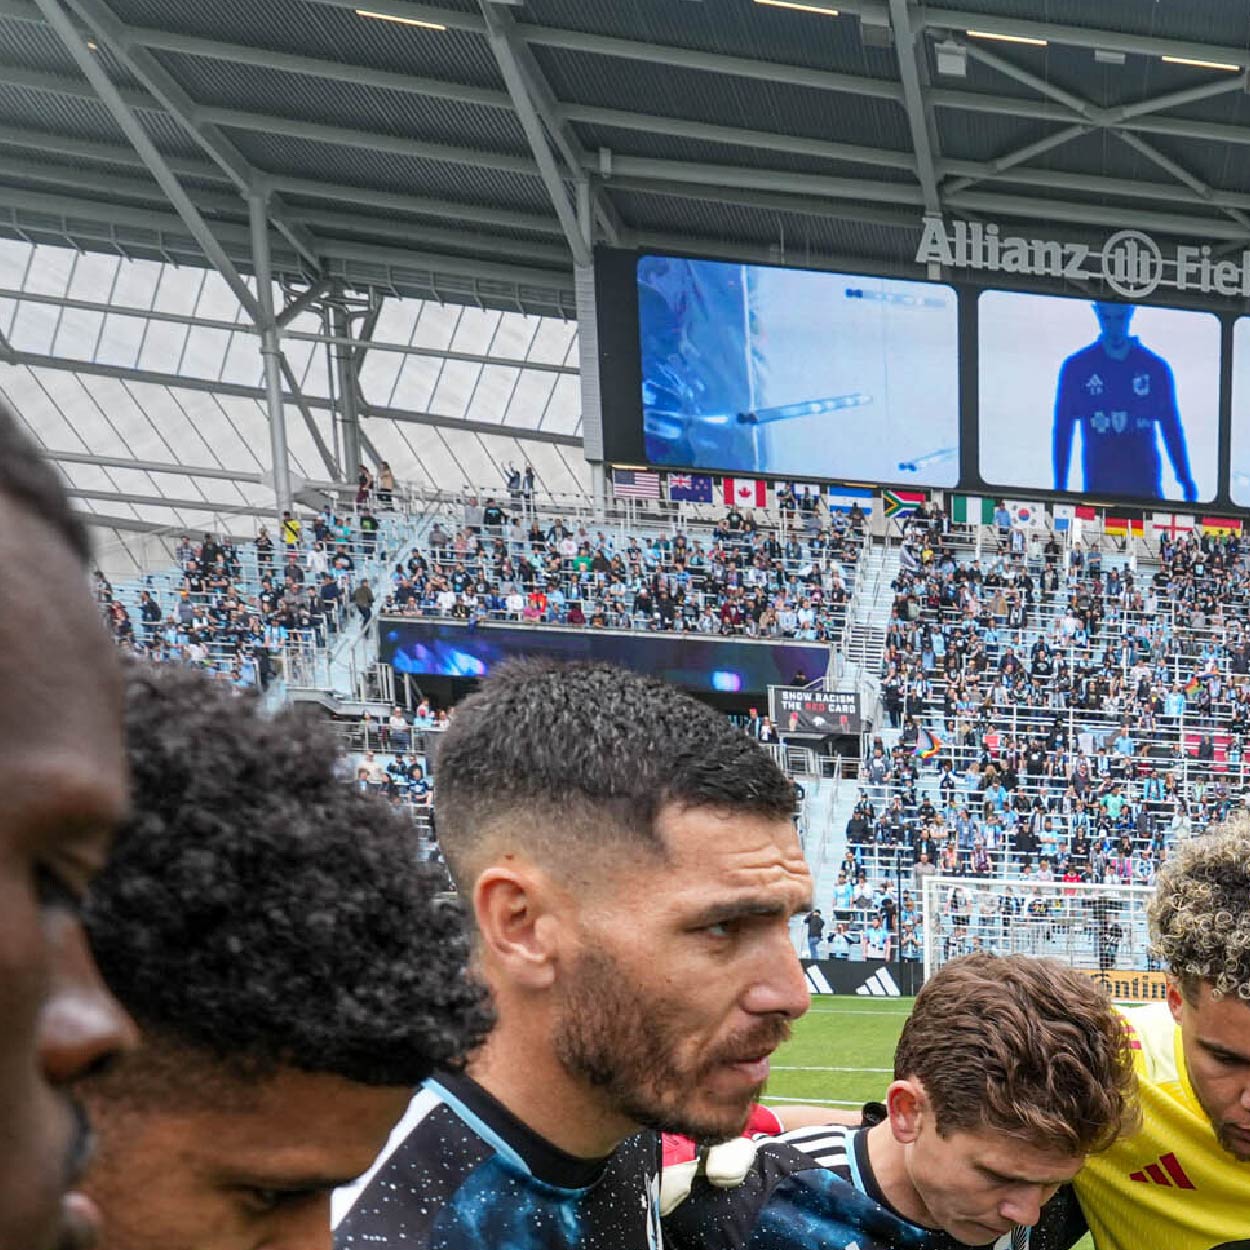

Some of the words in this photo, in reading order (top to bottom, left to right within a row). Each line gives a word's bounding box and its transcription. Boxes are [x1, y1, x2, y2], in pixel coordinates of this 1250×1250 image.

[916, 217, 1090, 280] Allianz
[782, 691, 812, 702] SHOW
[815, 692, 855, 704] RACISM
[781, 700, 802, 711] THE
[805, 702, 826, 712] RED
[828, 704, 856, 714] CARD
